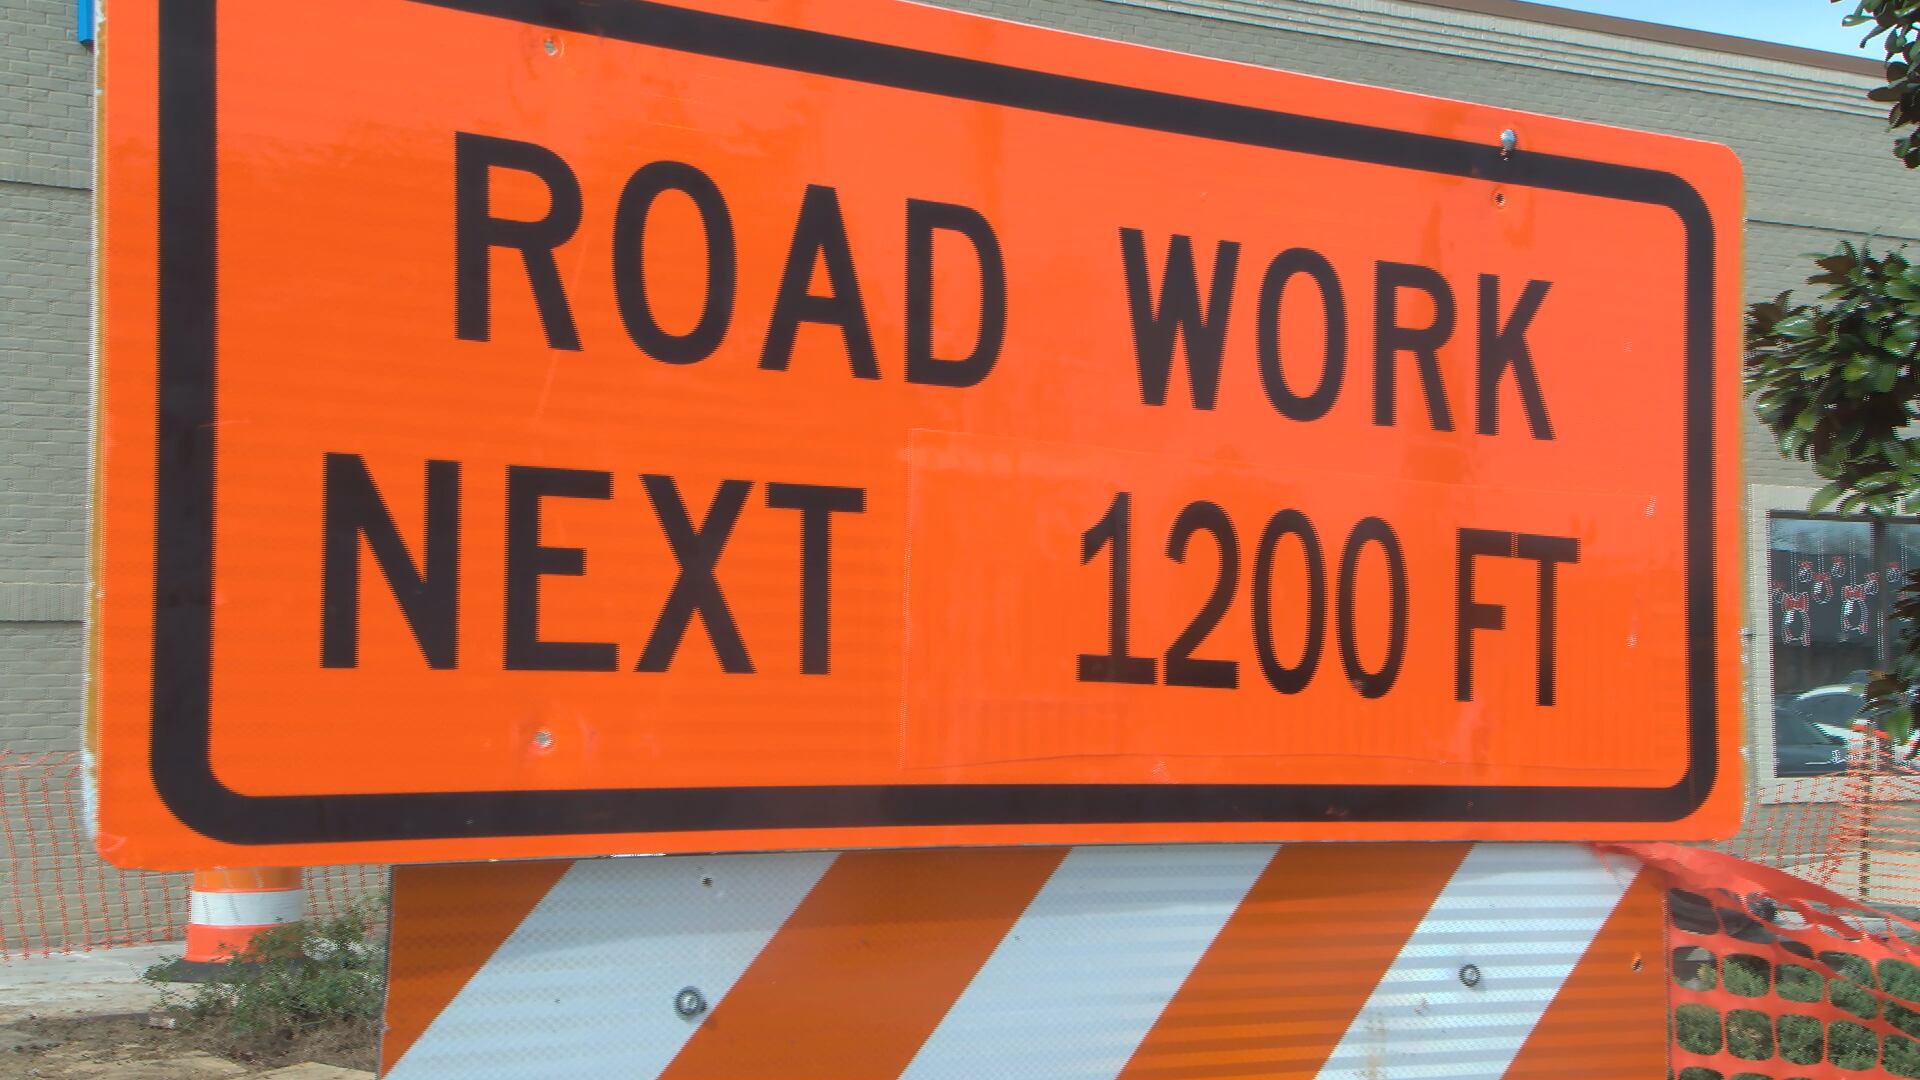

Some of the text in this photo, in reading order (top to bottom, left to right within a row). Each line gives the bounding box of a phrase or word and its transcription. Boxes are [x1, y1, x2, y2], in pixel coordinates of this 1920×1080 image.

[454, 131, 1554, 441] ROAD WORK
[319, 452, 1579, 707] NEXT 1200 FT
